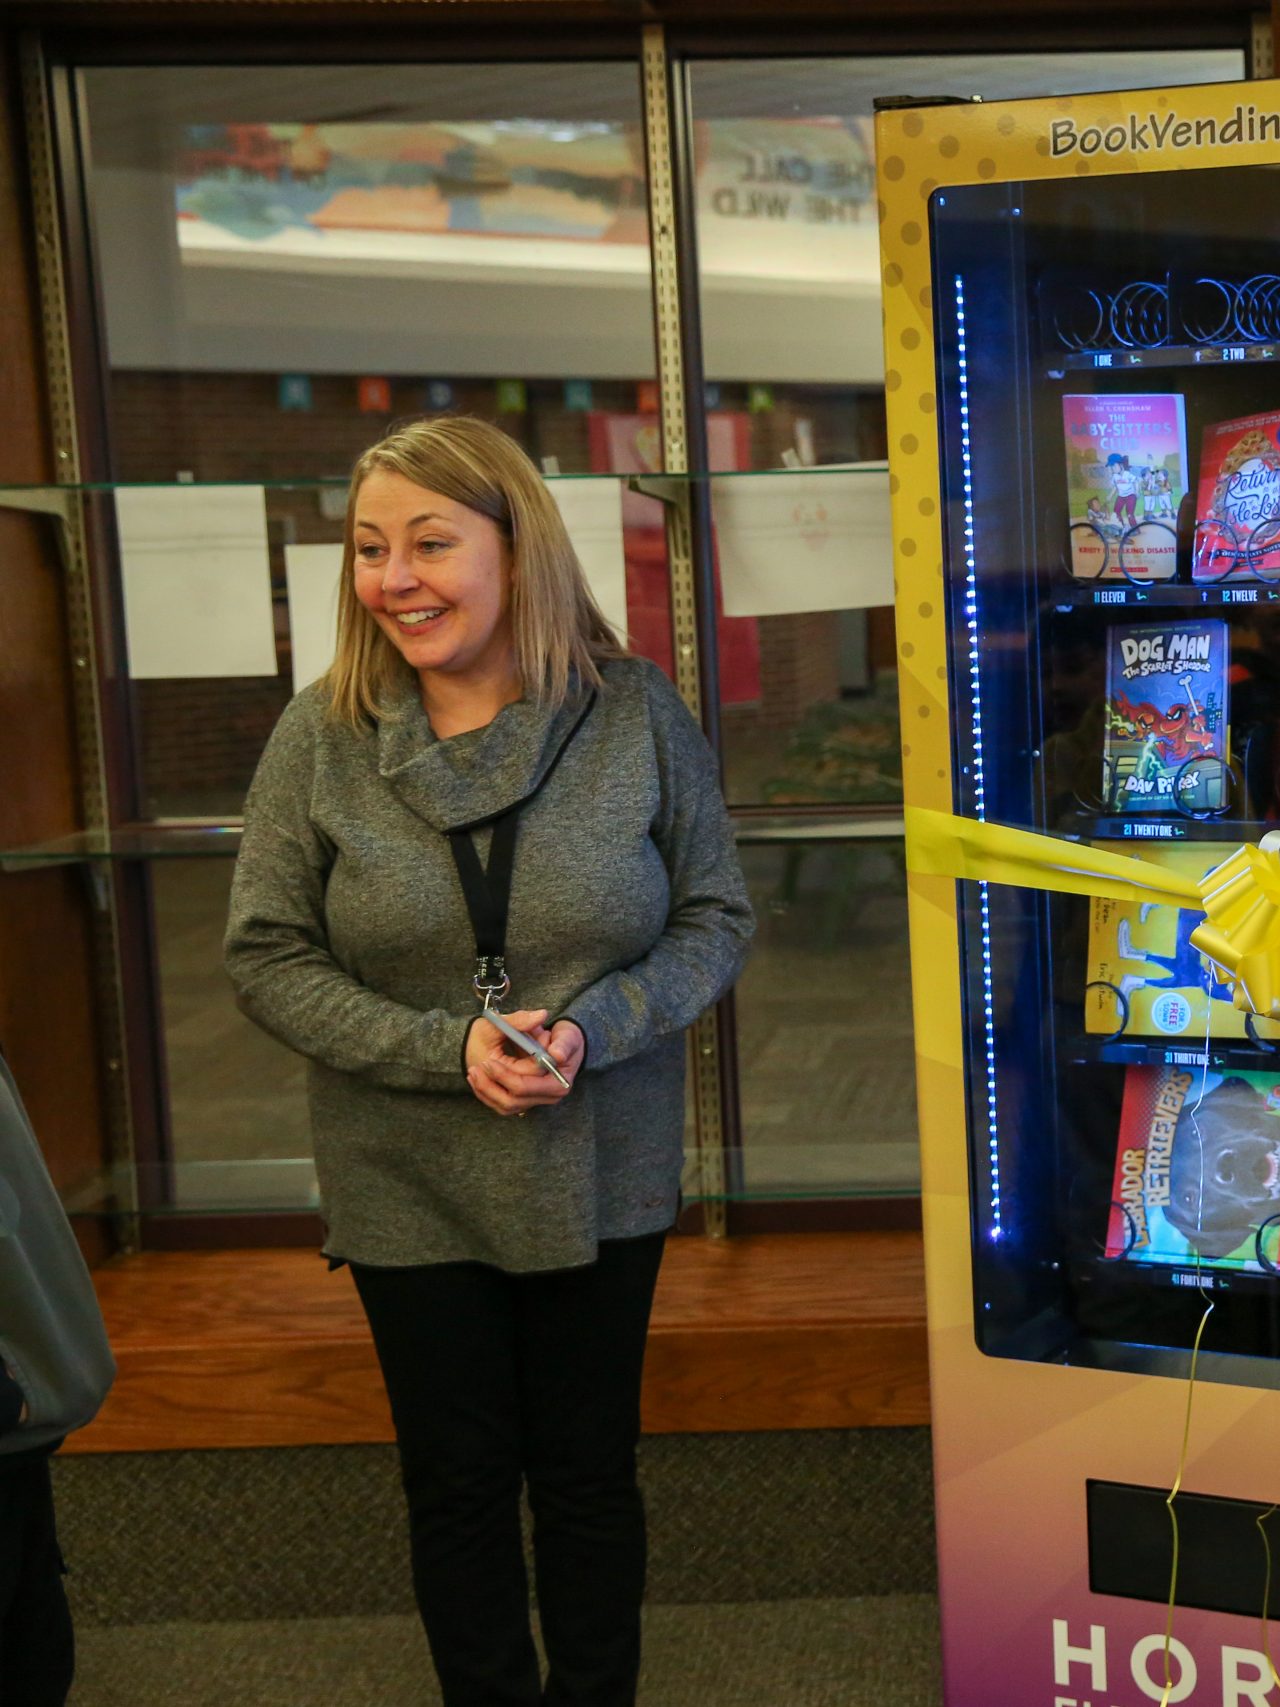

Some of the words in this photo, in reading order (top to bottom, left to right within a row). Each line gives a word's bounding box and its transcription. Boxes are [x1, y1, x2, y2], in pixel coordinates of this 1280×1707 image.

[1222, 349, 1229, 360] 2
[1230, 348, 1245, 360] TWO
[1101, 591, 1126, 603] ELEVEN
[1222, 590, 1230, 602] 12
[1231, 590, 1258, 602] TWELVE
[1121, 635, 1164, 666] DOG
[1167, 634, 1210, 660] MAN
[1125, 775, 1155, 794] DAV
[1123, 824, 1132, 835] 21
[1133, 824, 1159, 836] TWENTY
[1160, 825, 1173, 837] ONE
[1169, 1002, 1179, 1026] FREE
[1165, 1052, 1172, 1063] 31
[1174, 1052, 1197, 1065] THIRTY
[1146, 1068, 1193, 1207] RETRIEVERS
[1172, 1273, 1179, 1284] 41
[1200, 1276, 1214, 1288] ONE
